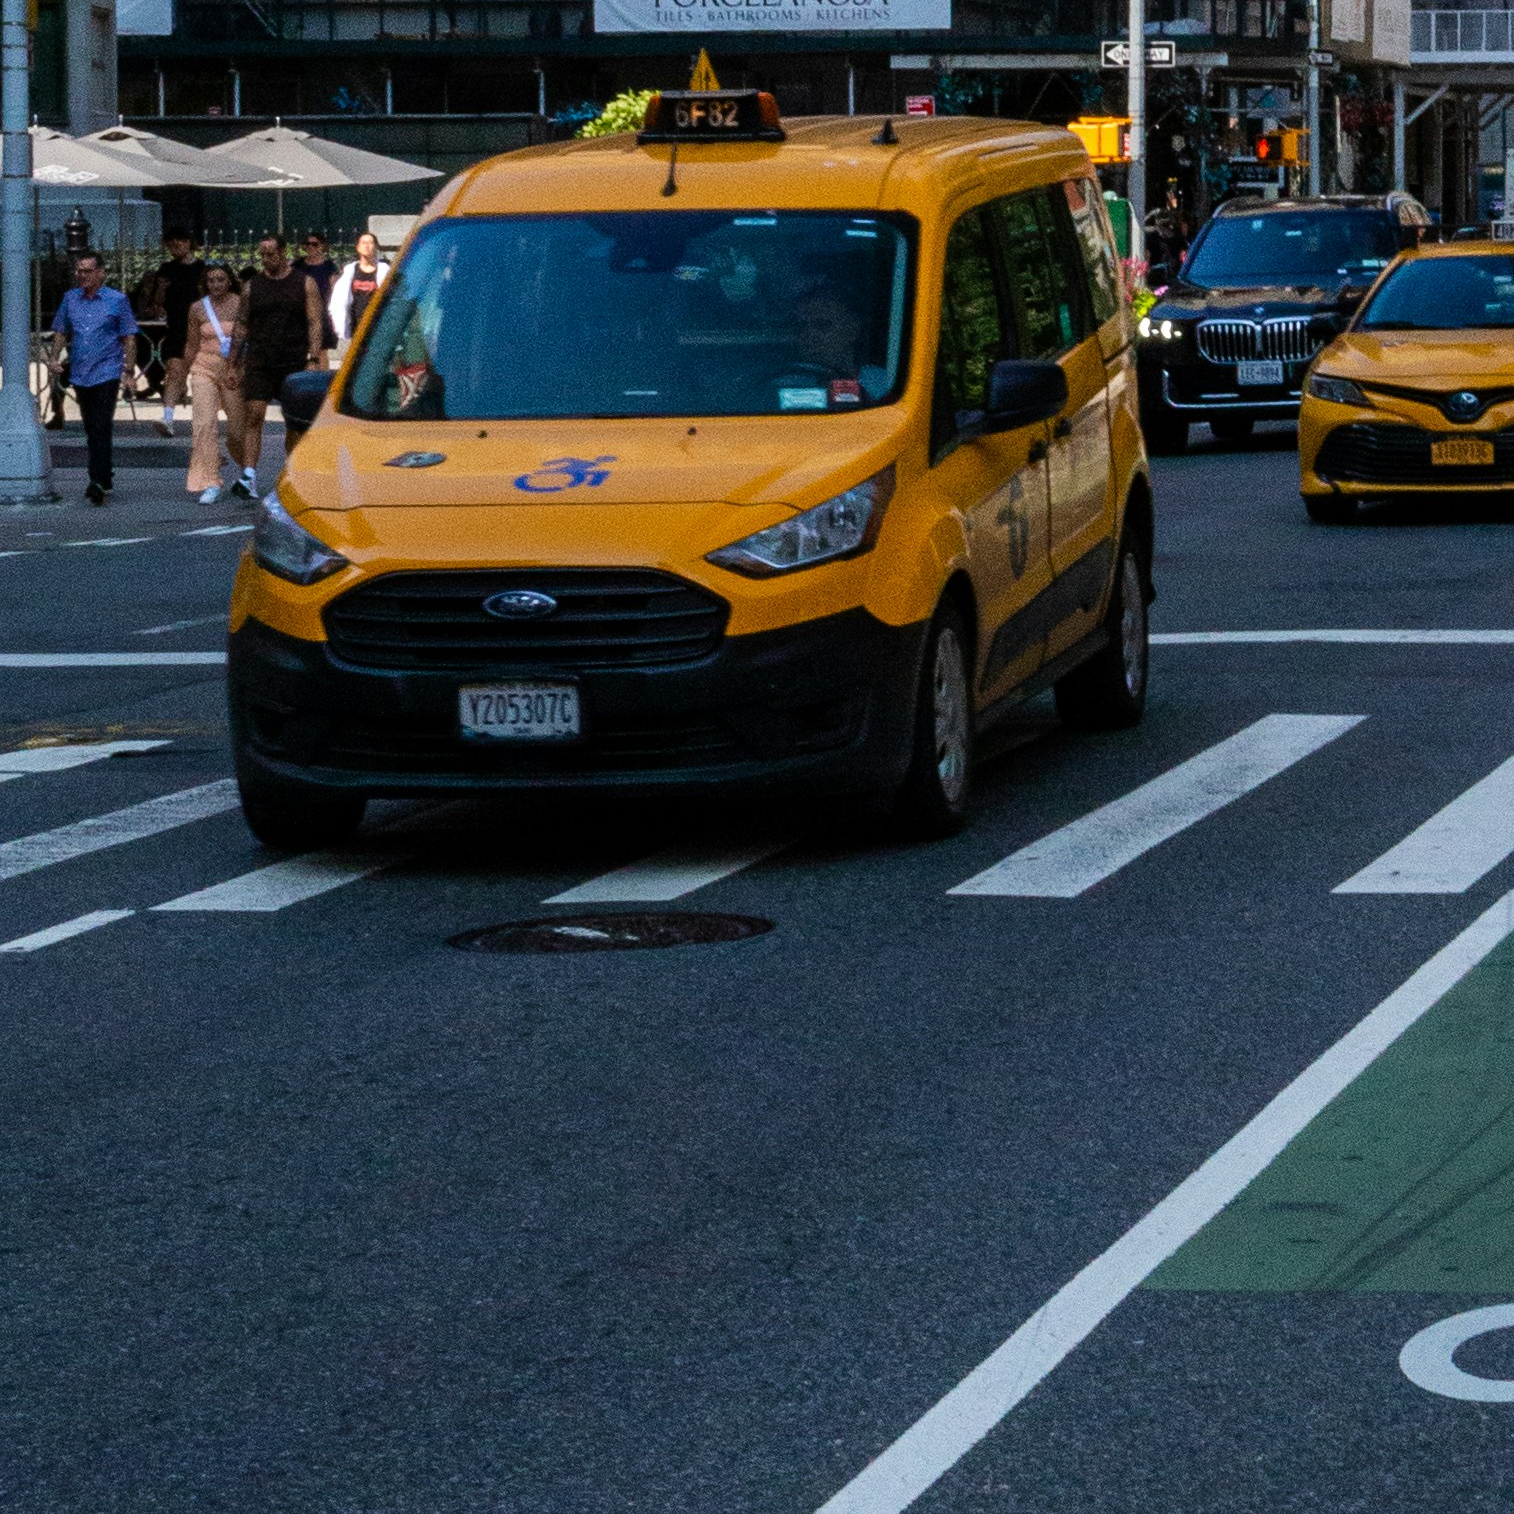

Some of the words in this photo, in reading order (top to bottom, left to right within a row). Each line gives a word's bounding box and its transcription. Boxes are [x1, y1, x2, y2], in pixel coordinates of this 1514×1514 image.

[655, 9, 693, 22] TILES
[707, 9, 801, 21] BATHROOMS
[815, 8, 891, 21] KITCHENS
[674, 99, 738, 128] 6F82
[470, 692, 571, 725] Y205307C
